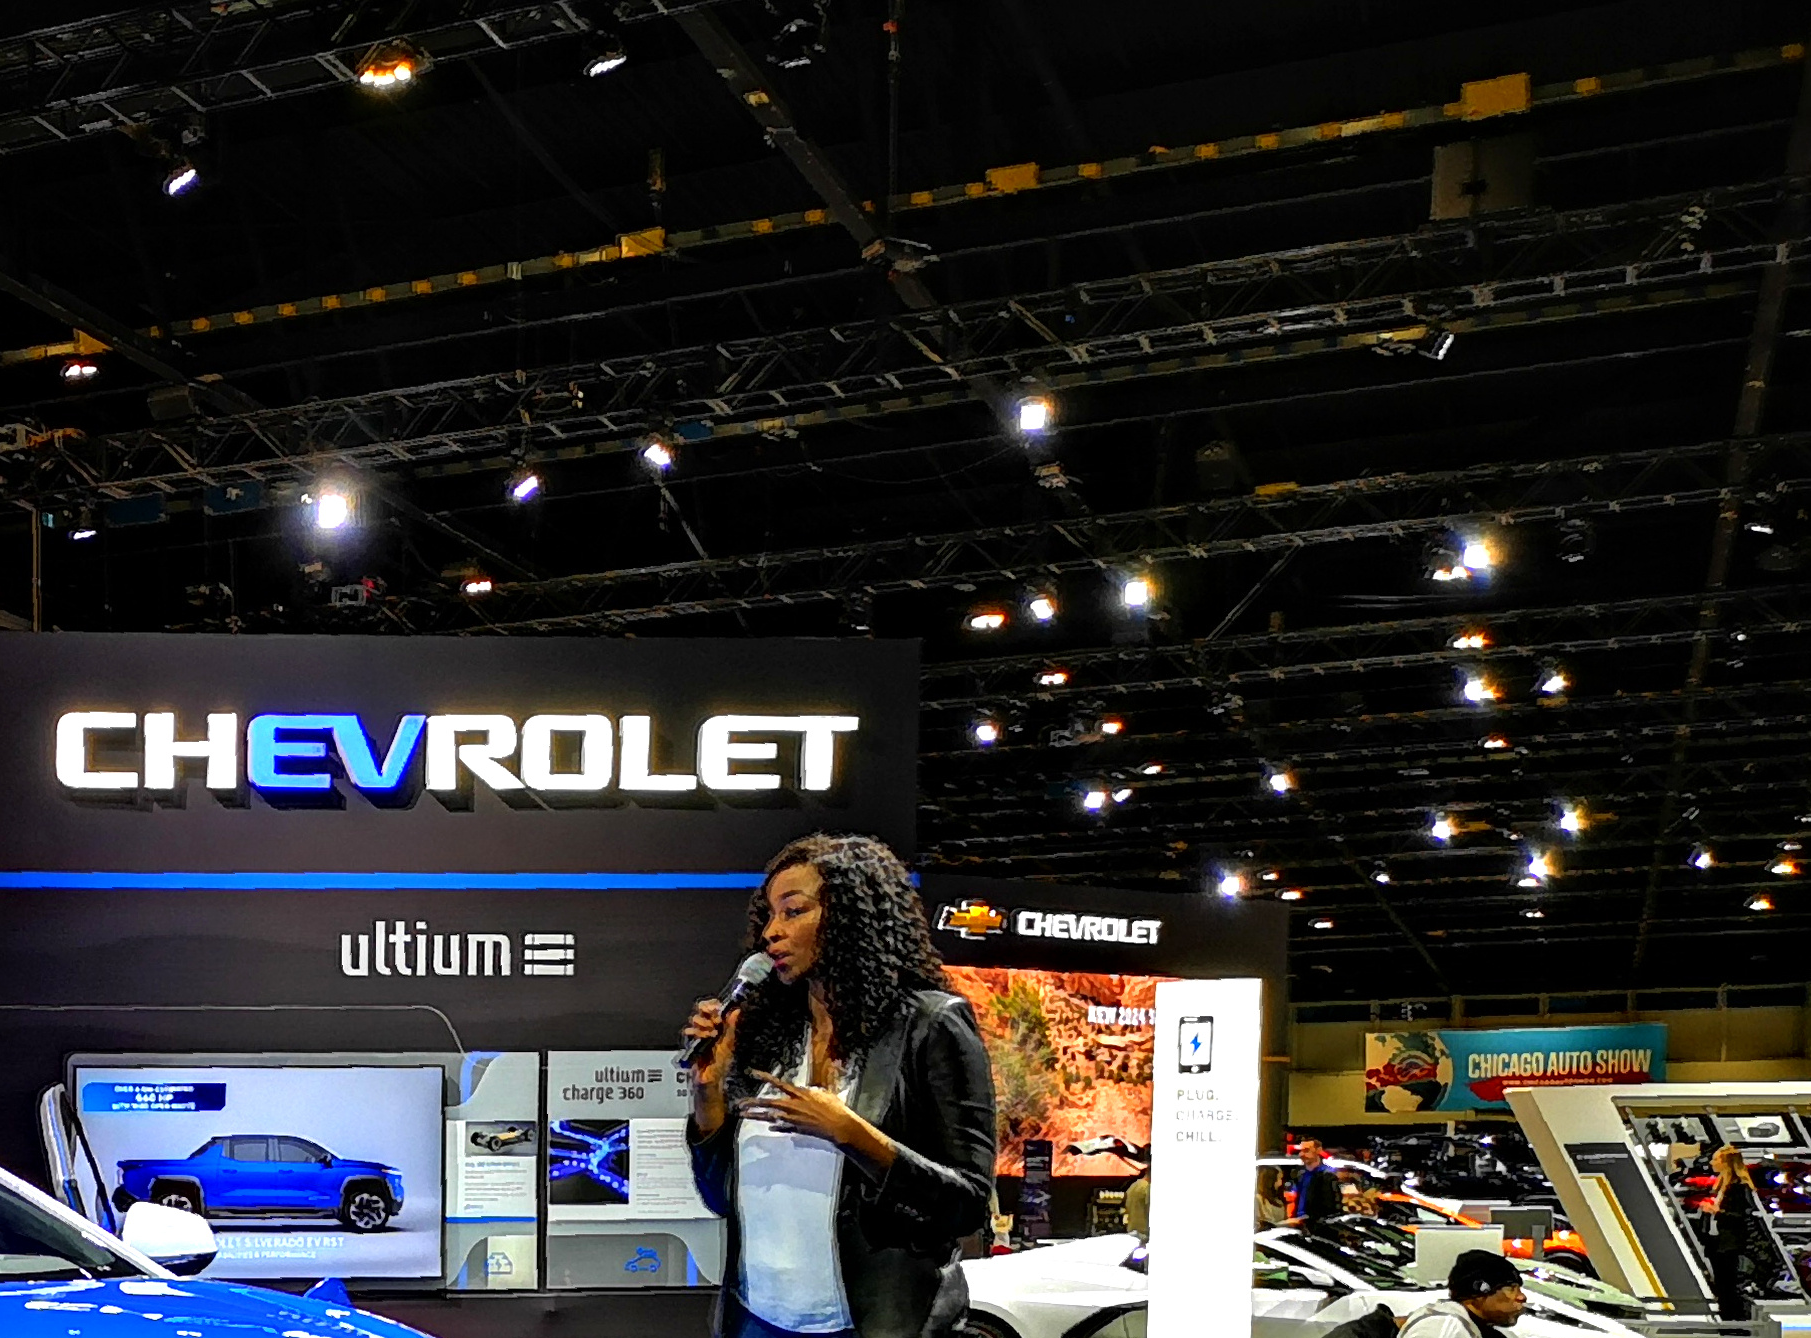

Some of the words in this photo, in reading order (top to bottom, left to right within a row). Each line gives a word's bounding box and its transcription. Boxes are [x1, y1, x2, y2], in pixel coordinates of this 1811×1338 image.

[56, 711, 859, 790] CHEVROLET
[1017, 911, 1162, 944] CHEVROLET
[341, 920, 511, 976] ultium
[1468, 1052, 1543, 1078] CHICAGO
[1547, 1050, 1591, 1076] AUTO
[1595, 1048, 1653, 1074] SHOW
[594, 1066, 645, 1083] ultium
[562, 1084, 614, 1104] charge
[618, 1086, 645, 1100] 360
[1176, 1089, 1219, 1101] PLUG.
[1176, 1110, 1239, 1121] CHARGE.
[1176, 1131, 1222, 1142] CHILL.
[244, 1236, 304, 1248] SLVERADO
